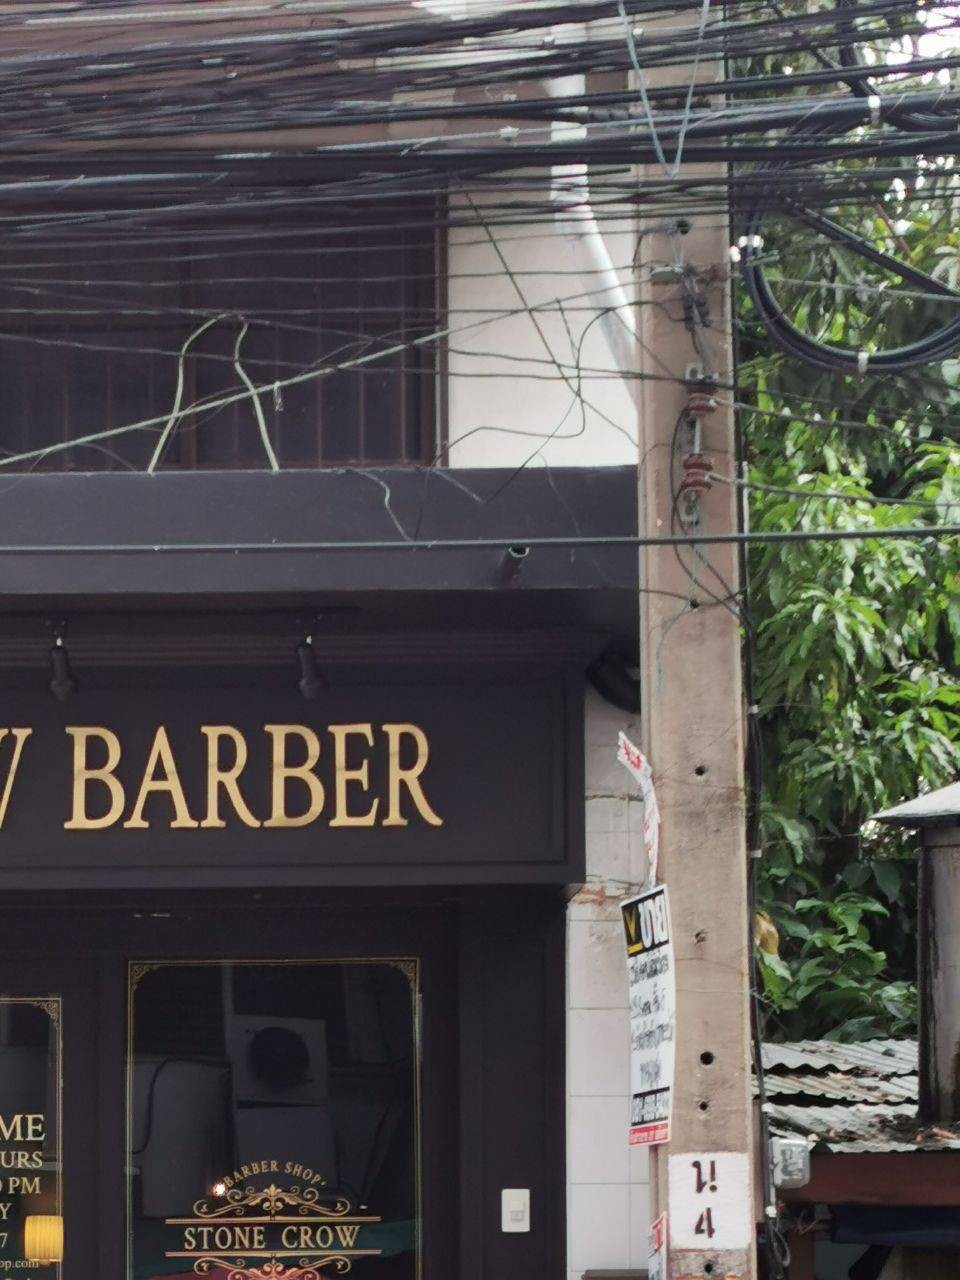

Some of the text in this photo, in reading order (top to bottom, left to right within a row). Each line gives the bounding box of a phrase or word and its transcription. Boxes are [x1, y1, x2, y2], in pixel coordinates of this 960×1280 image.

[63, 723, 444, 829] BARBER
[8, 1177, 41, 1194] PM
[224, 1160, 321, 1188] BARBER SHOP
[184, 1225, 360, 1250] STONE CROW
